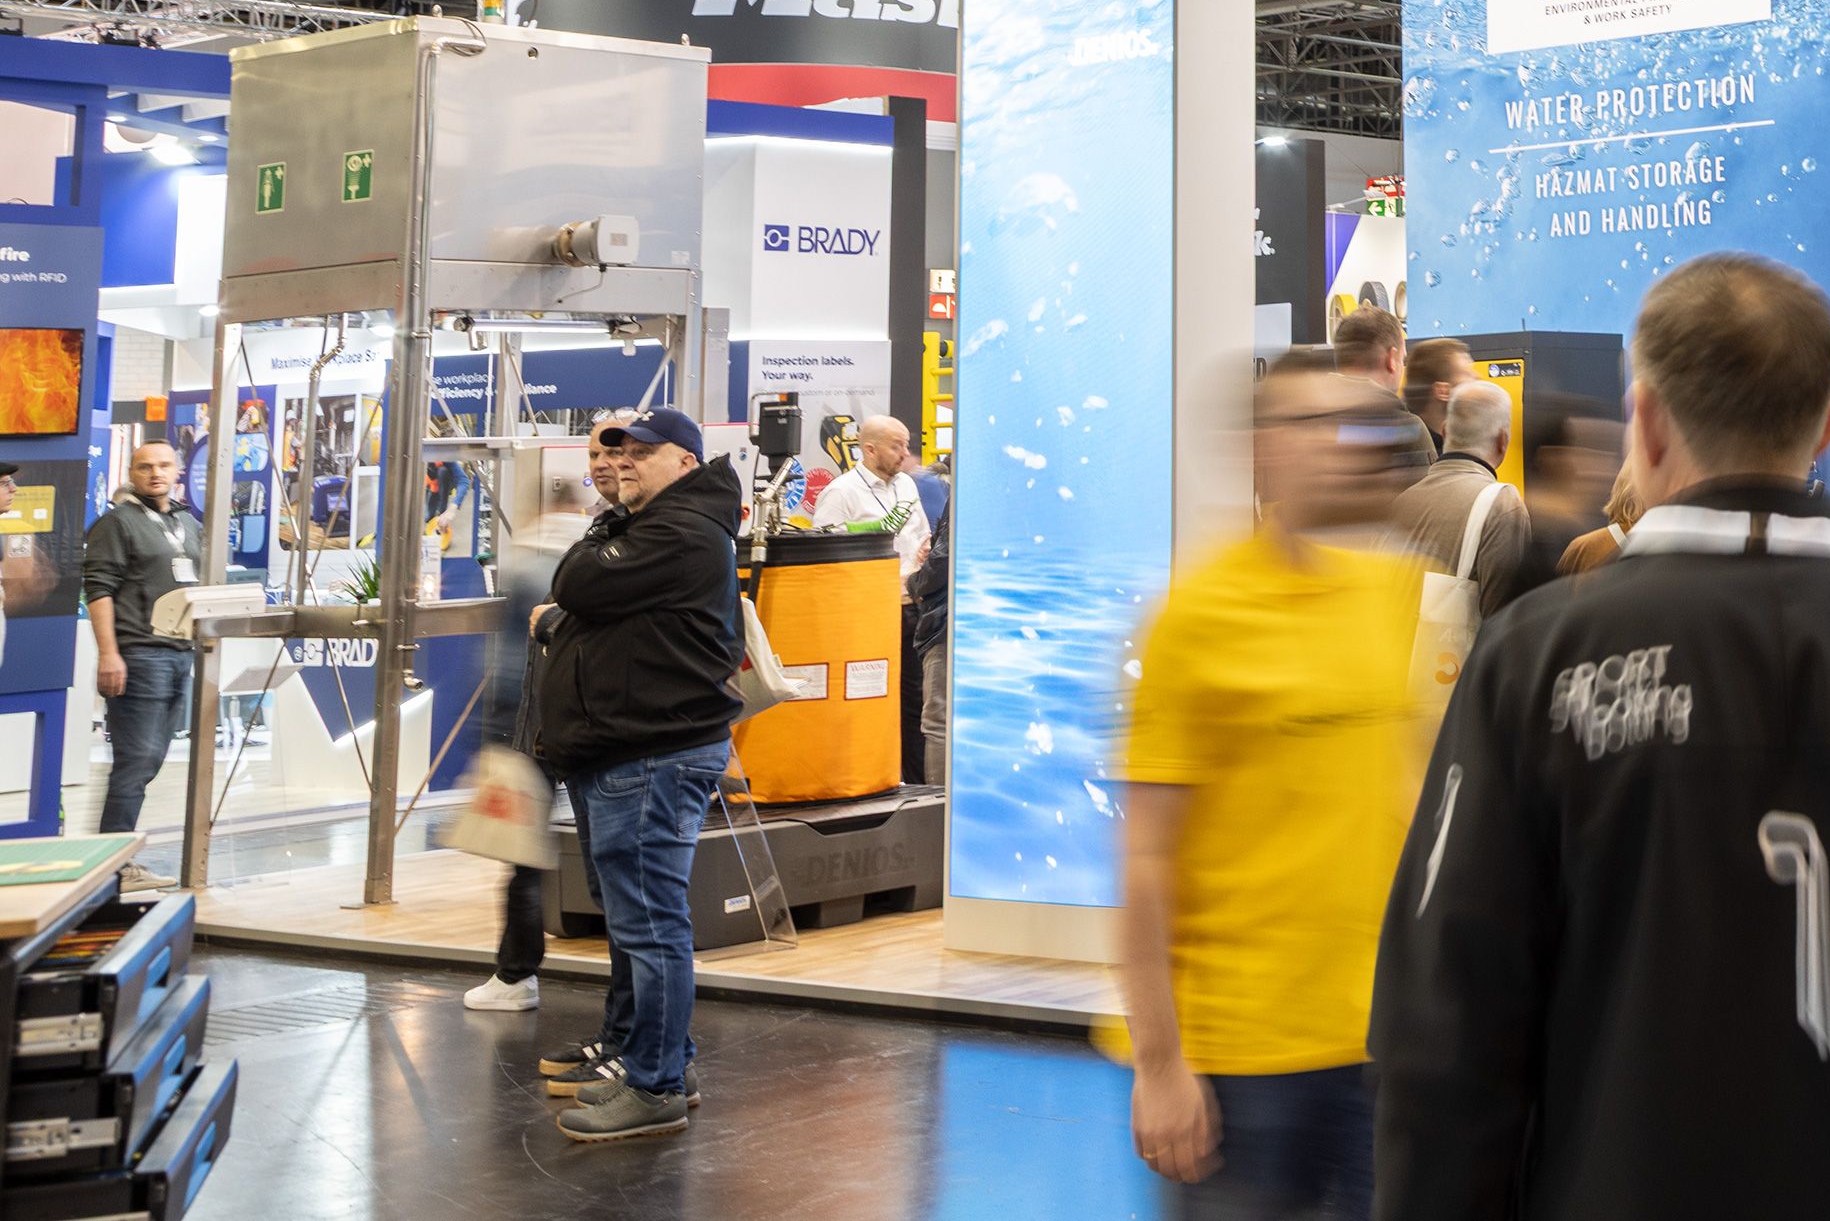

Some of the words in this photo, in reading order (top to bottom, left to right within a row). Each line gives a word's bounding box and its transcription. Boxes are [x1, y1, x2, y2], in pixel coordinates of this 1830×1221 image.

[1584, 14, 1591, 25] &
[1594, 10, 1627, 22] WORK
[1631, 4, 1672, 19] SAFETY
[1505, 94, 1584, 129] WATER
[1597, 74, 1755, 119] PROTECTION
[1535, 167, 1617, 199] HAZMAT
[1627, 156, 1726, 190] STORAGE
[1550, 209, 1591, 238] AND
[1602, 199, 1712, 234] HANDLING
[798, 226, 881, 255] BRADY
[39, 272, 68, 284] RFID
[762, 355, 818, 367] Inspection
[821, 356, 855, 366] labels.
[762, 370, 786, 380] Your
